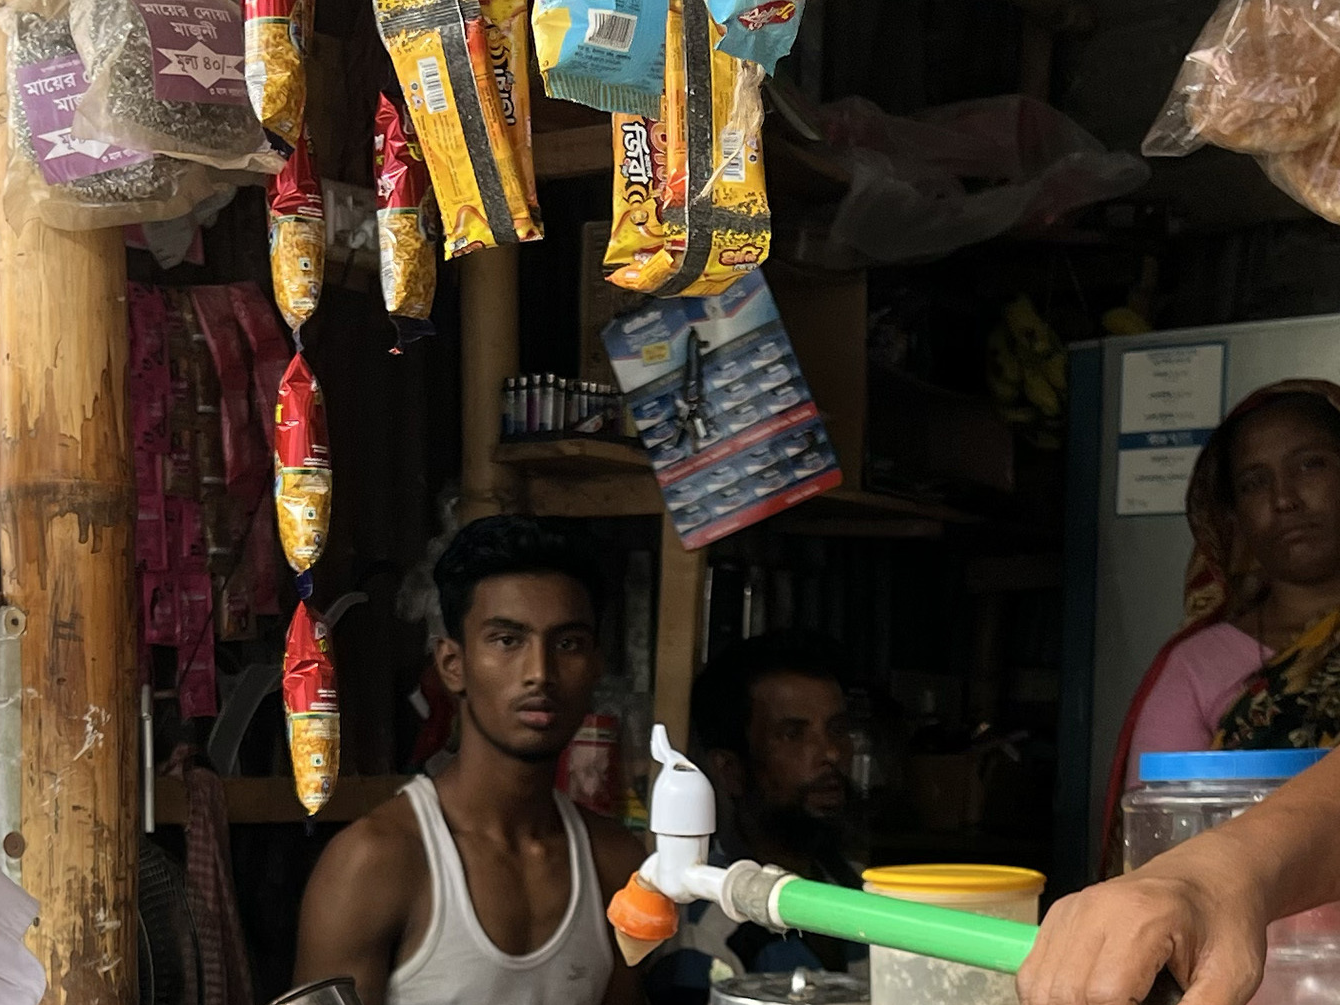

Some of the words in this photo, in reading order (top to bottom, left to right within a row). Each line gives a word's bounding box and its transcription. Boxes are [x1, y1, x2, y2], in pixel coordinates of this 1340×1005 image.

[140, 3, 189, 18] মায়ের
[193, 7, 232, 23] দোয়া
[174, 54, 199, 74] মূল্য
[23, 72, 76, 97] মায়ের
